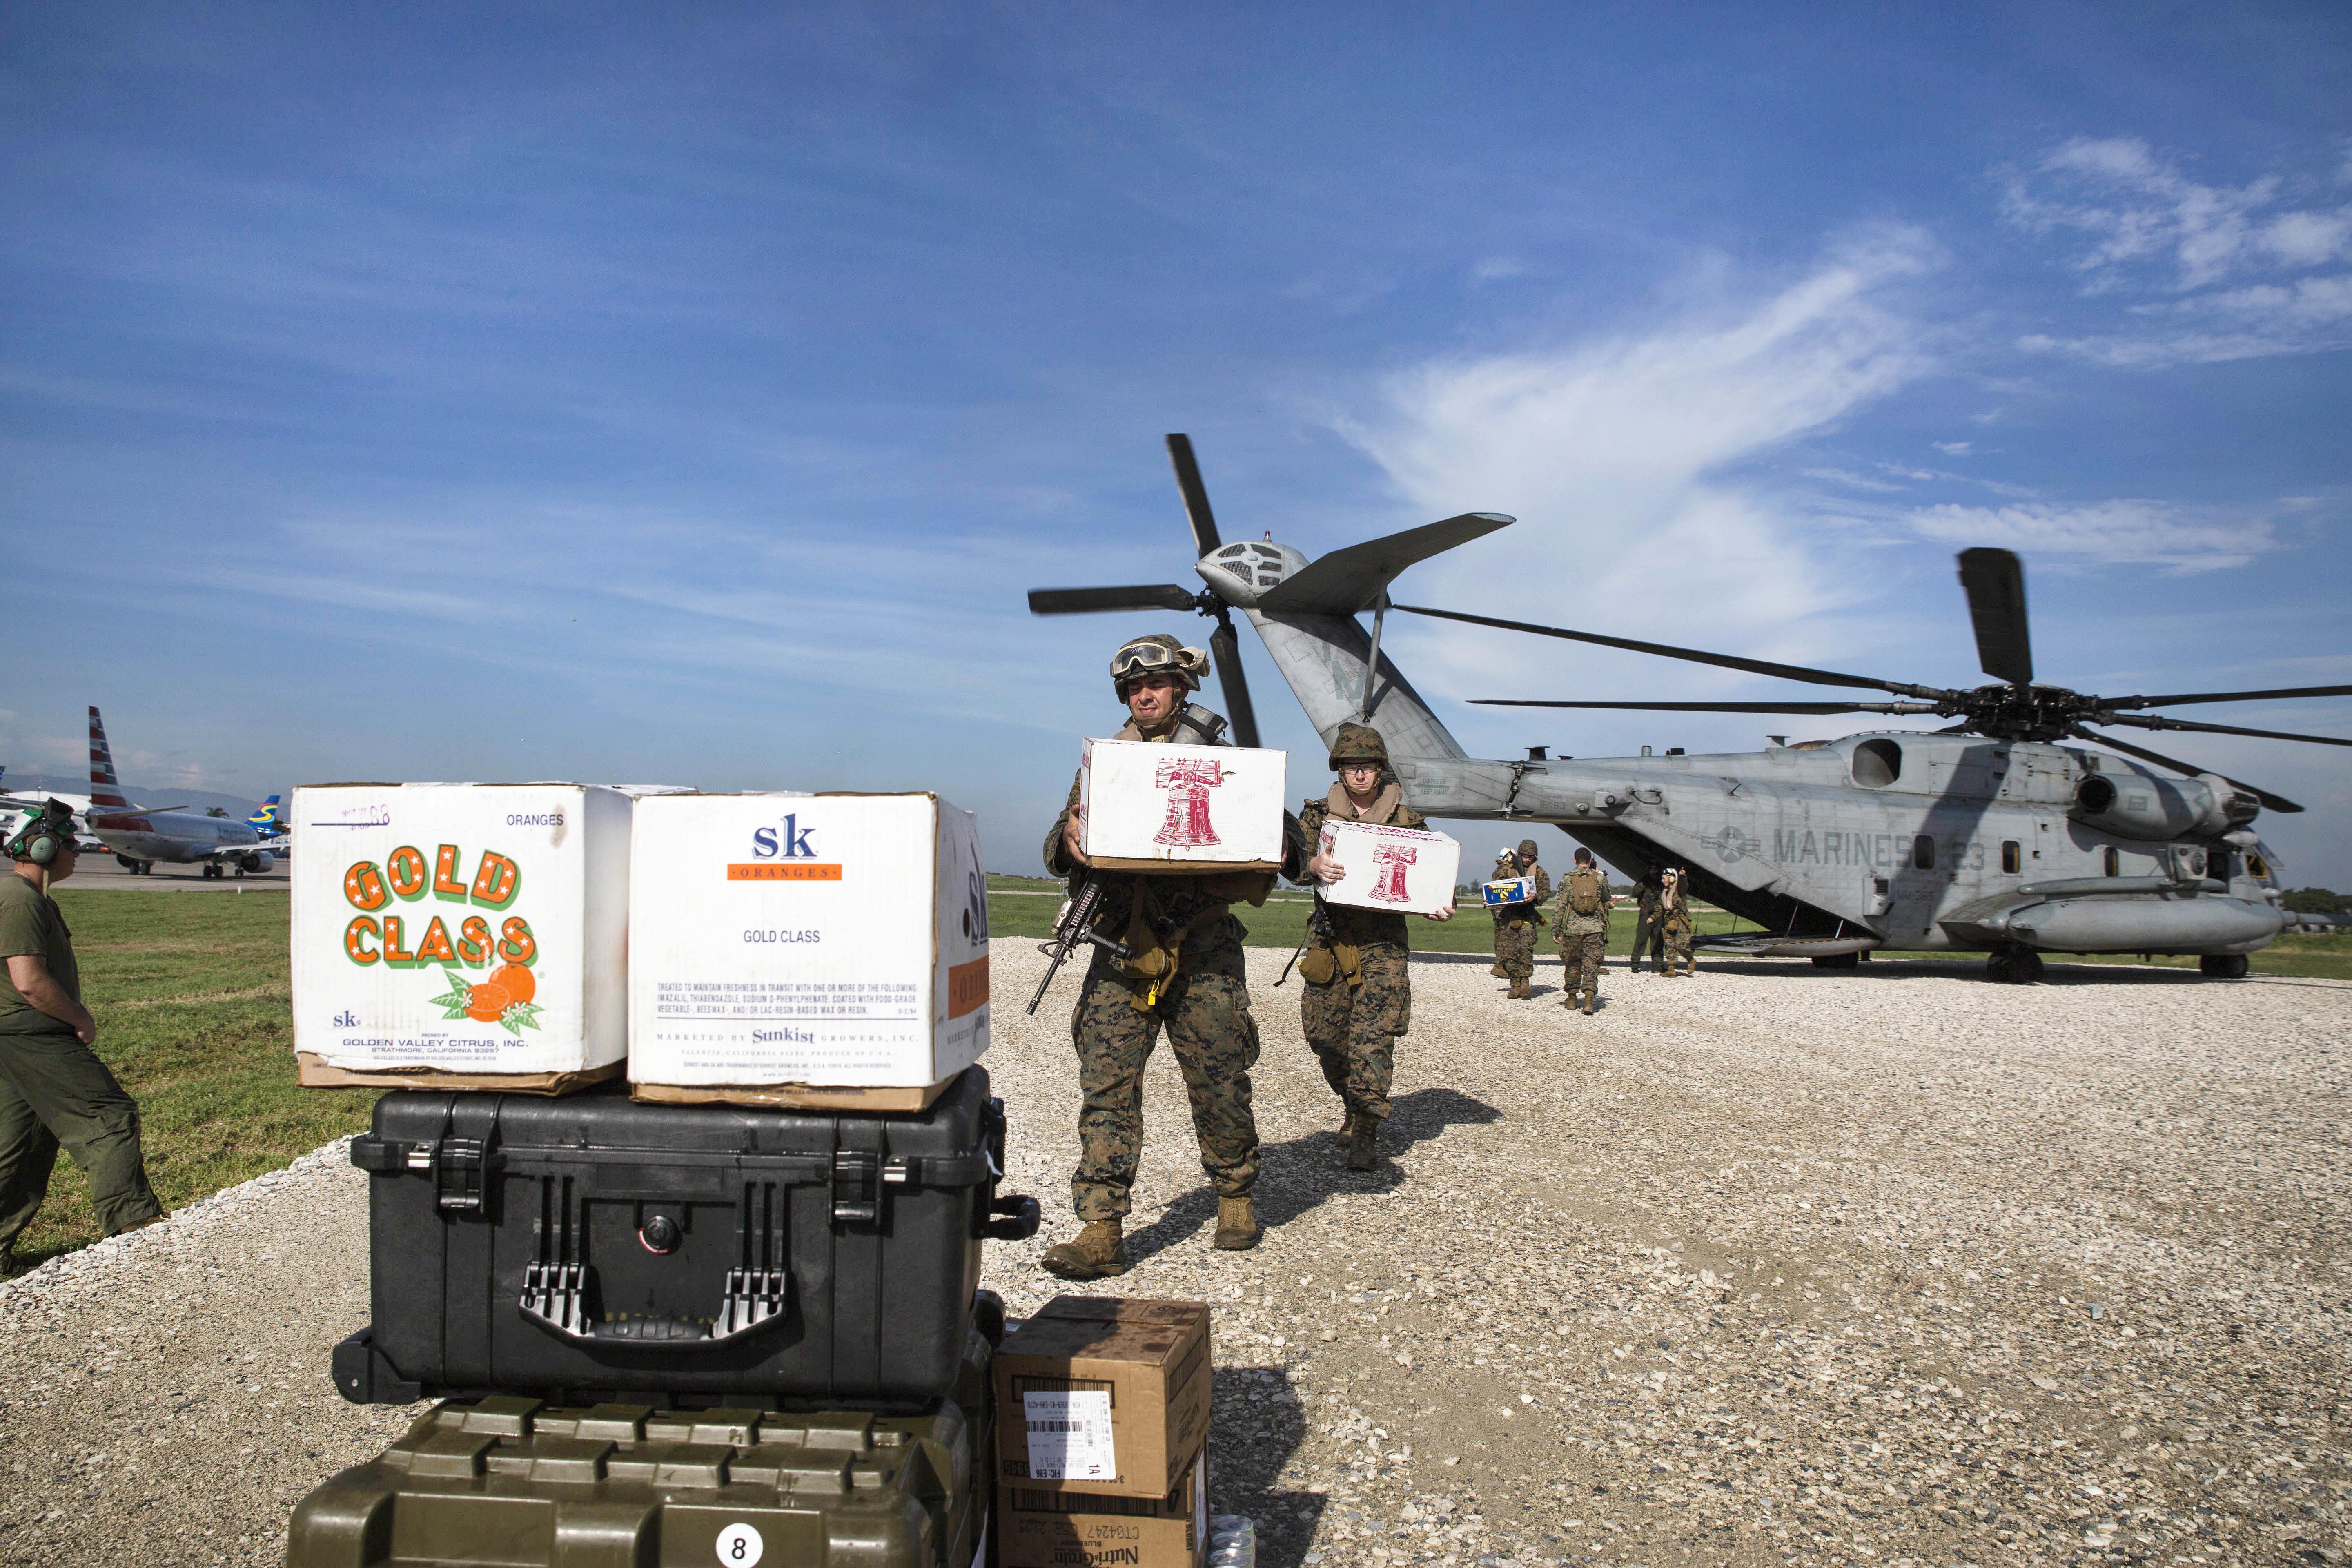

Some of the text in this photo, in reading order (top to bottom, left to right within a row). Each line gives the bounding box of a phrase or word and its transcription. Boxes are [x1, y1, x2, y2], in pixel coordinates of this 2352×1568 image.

[507, 814, 564, 826] ORANGES
[752, 813, 817, 860] sk
[1774, 829, 1913, 868] MARINES
[1952, 842, 1985, 871] 23
[344, 844, 521, 912] GOLD
[740, 867, 828, 878] ORANGES
[344, 915, 539, 969] CLASS
[744, 931, 820, 943] GOLD CLASS
[658, 983, 682, 991] TREATED
[333, 1010, 356, 1027] sk
[753, 1027, 815, 1043] Sunkist
[449, 1040, 499, 1048] CITRUS,
[1036, 1469, 1060, 1477] FIC: E86
[1089, 1464, 1100, 1474] 1A
[733, 1538, 745, 1559] 8
